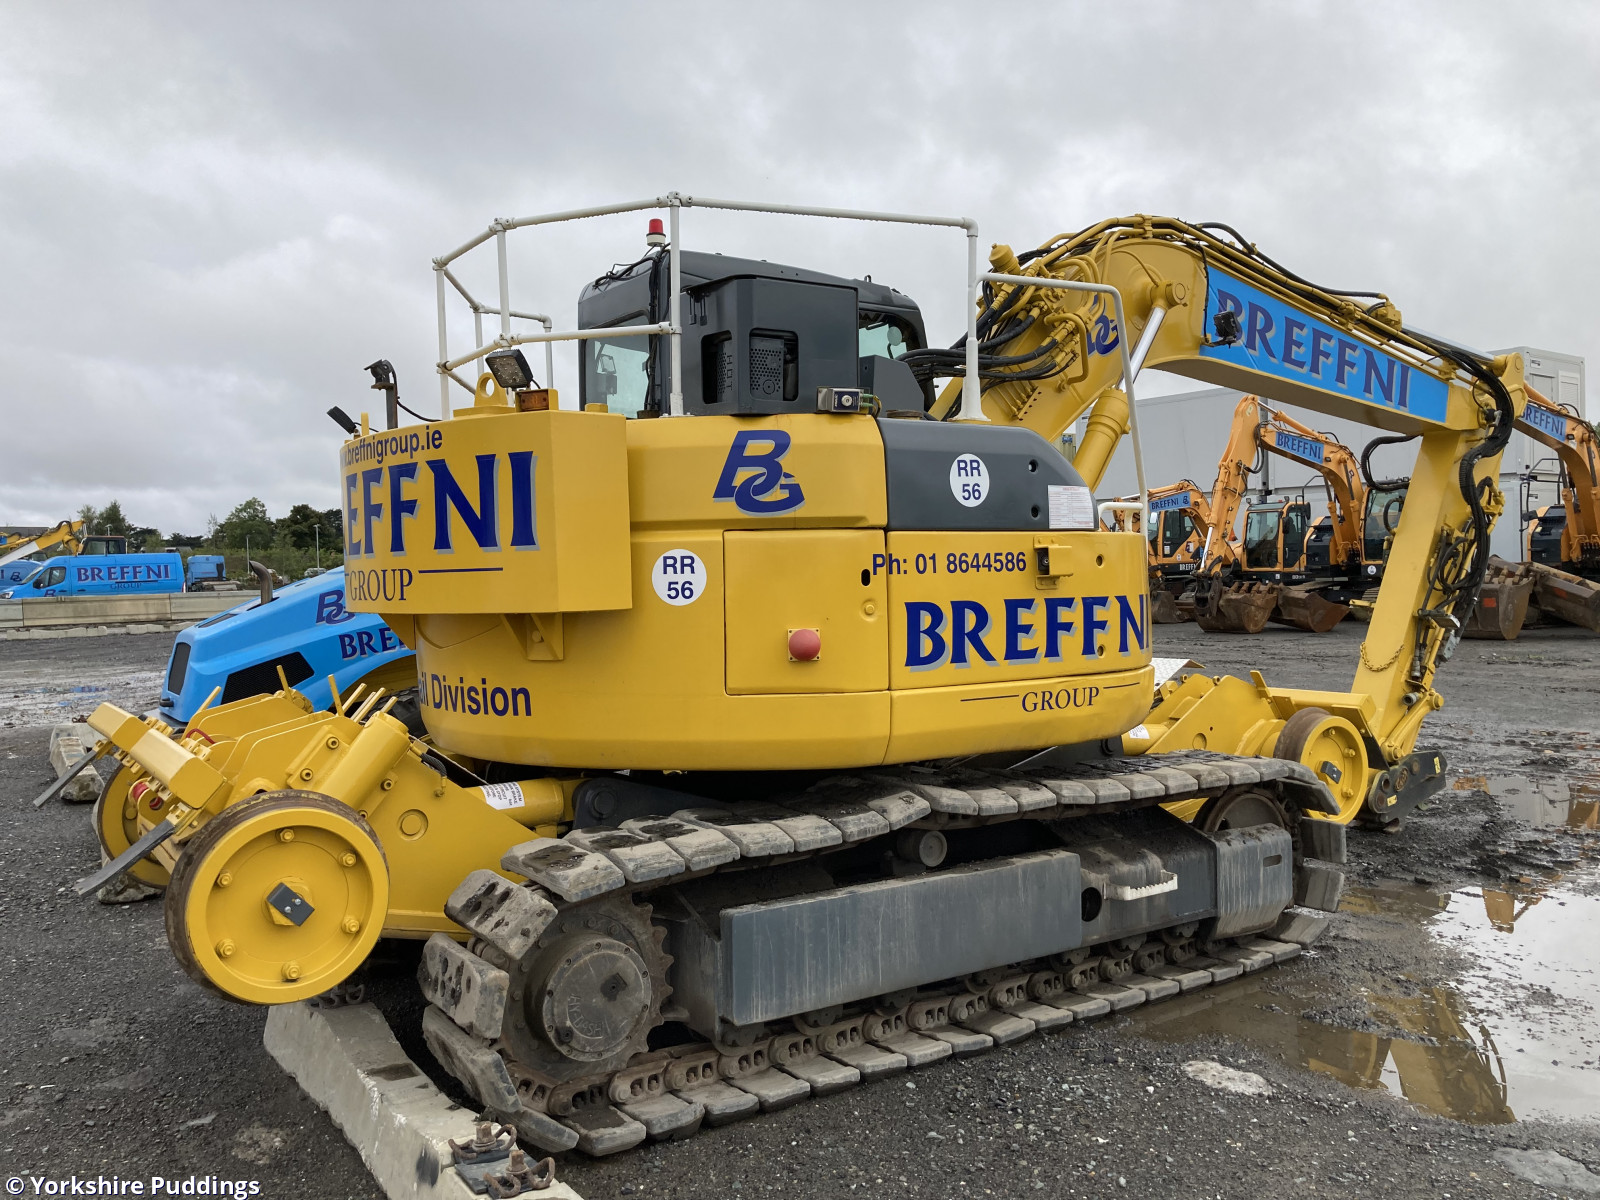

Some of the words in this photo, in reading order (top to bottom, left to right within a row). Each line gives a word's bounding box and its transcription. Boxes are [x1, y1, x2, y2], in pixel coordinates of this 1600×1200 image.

[1215, 288, 1413, 411] BREFFNI
[1276, 432, 1322, 460] BREFFNI
[956, 459, 982, 477] RR
[961, 483, 982, 501] 56
[1151, 497, 1179, 510] BREFFNI
[344, 451, 541, 560] EFFNI
[76, 564, 171, 583] BREFFNI
[662, 555, 696, 575] RR
[872, 553, 908, 576] Ph:
[915, 552, 938, 575] 01
[946, 551, 1027, 574] 8644586
[109, 582, 142, 590] GROUP
[350, 568, 414, 602] GROUP
[666, 580, 694, 600] 56
[904, 594, 1150, 673] BREFFNI
[431, 673, 532, 717] Division
[1021, 686, 1100, 713] GROUP
